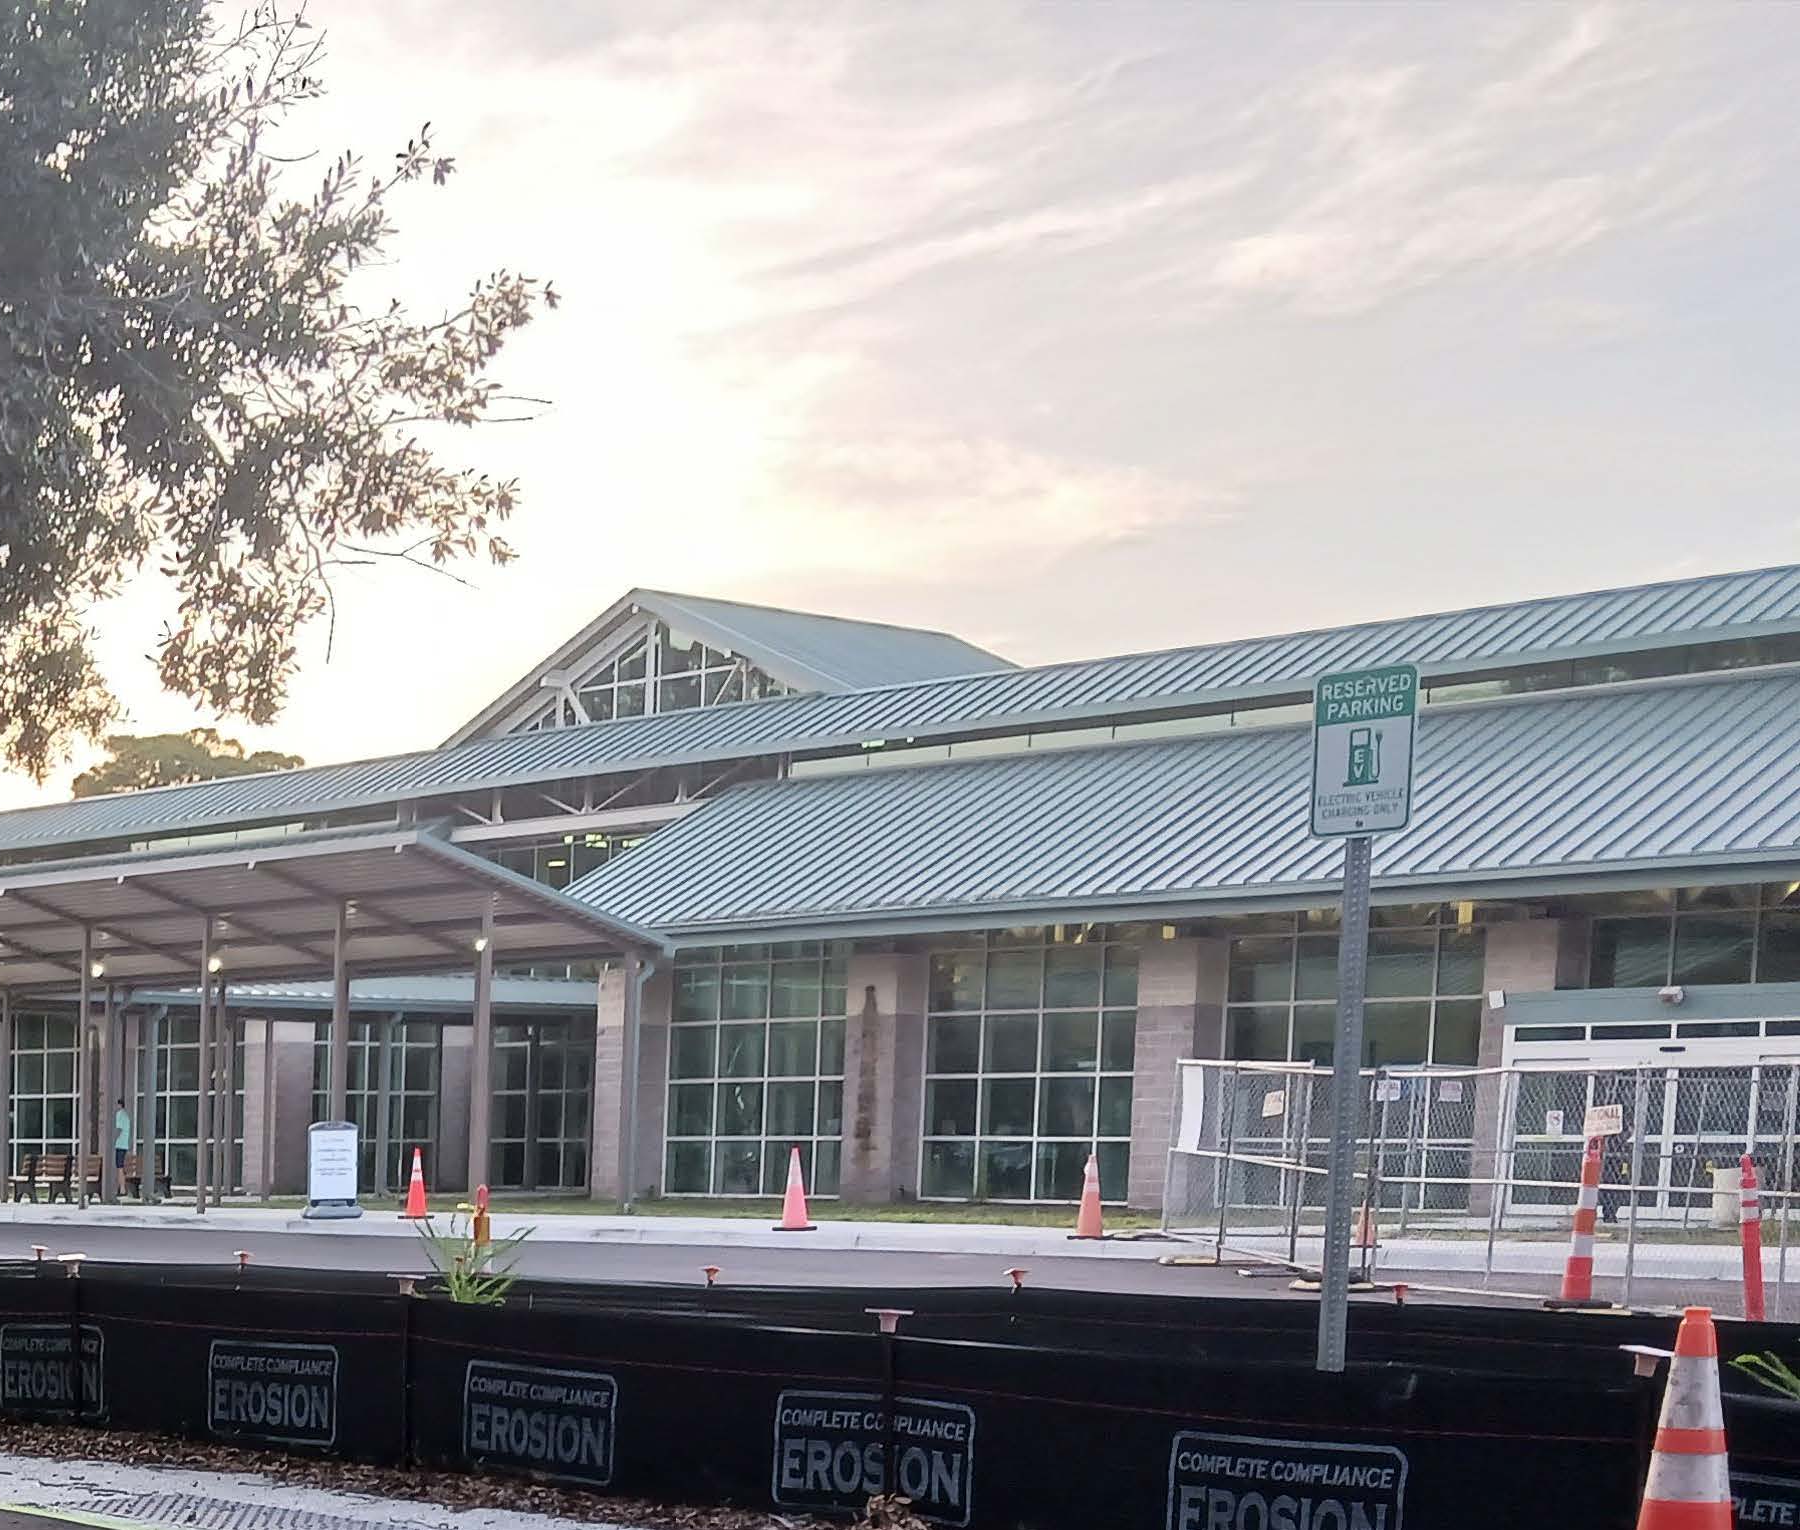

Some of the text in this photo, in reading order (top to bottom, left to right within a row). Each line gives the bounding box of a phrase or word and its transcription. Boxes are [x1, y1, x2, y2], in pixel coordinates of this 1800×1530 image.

[1321, 673, 1411, 701] RESERVED
[1327, 694, 1404, 721] PARKING
[213, 1354, 333, 1377] COMPLETE COMPLIANCE
[213, 1378, 329, 1429] EROSION
[469, 1376, 610, 1409] COMPLETE COMPLIANCE
[471, 1402, 606, 1467] EROSION
[781, 1408, 862, 1431] COMPLETE
[1178, 1452, 1395, 1490] COMPLETE COMPLIANCE
